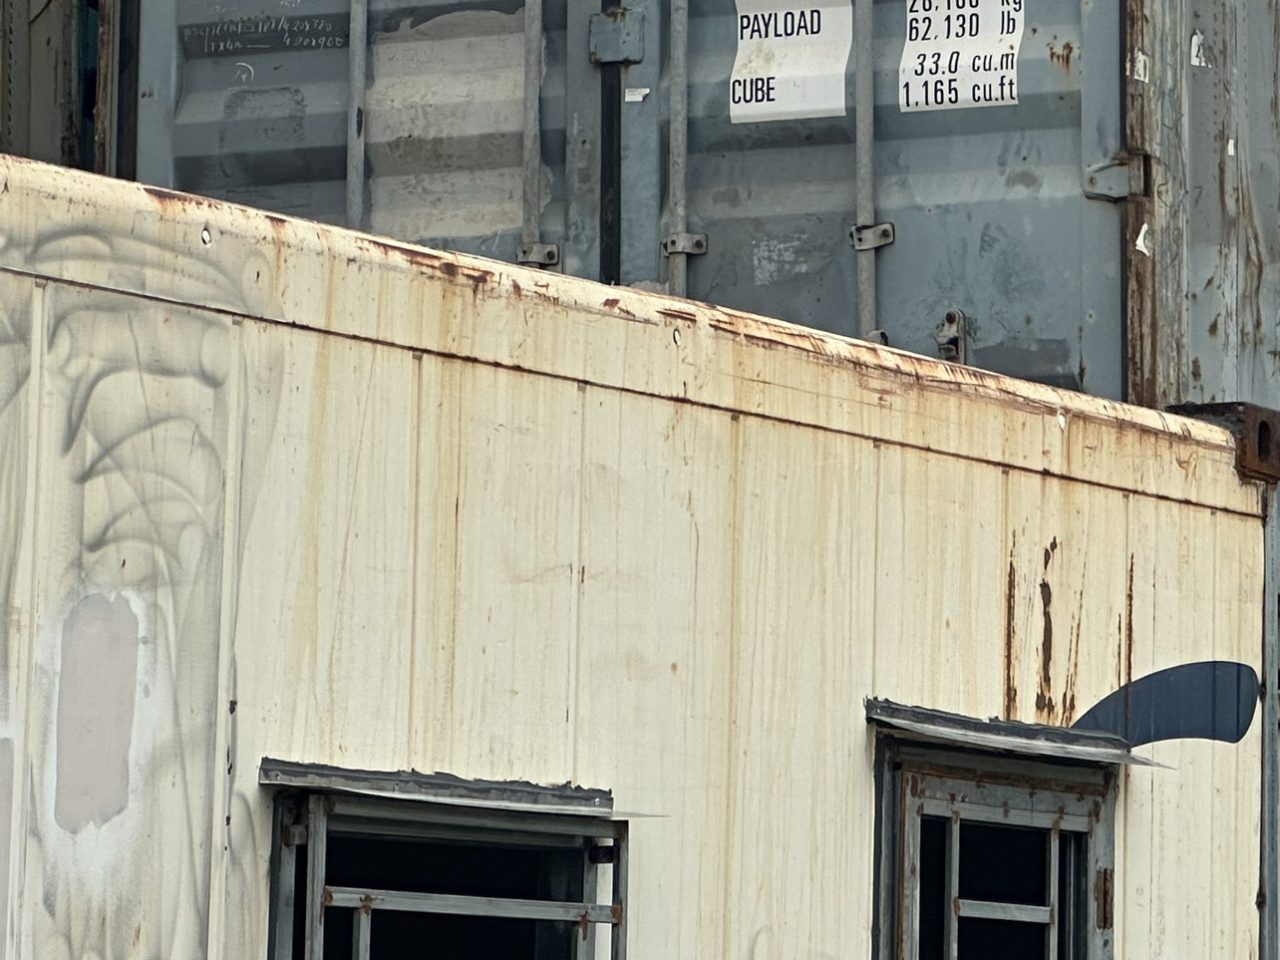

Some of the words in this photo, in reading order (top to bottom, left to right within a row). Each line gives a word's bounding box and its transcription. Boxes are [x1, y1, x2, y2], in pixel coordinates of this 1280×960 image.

[739, 10, 822, 40] PAYLOAD
[999, 10, 1016, 36] lb
[914, 51, 960, 76] 33.0
[732, 76, 776, 104] CUBE
[971, 75, 1016, 103] cu.ft
